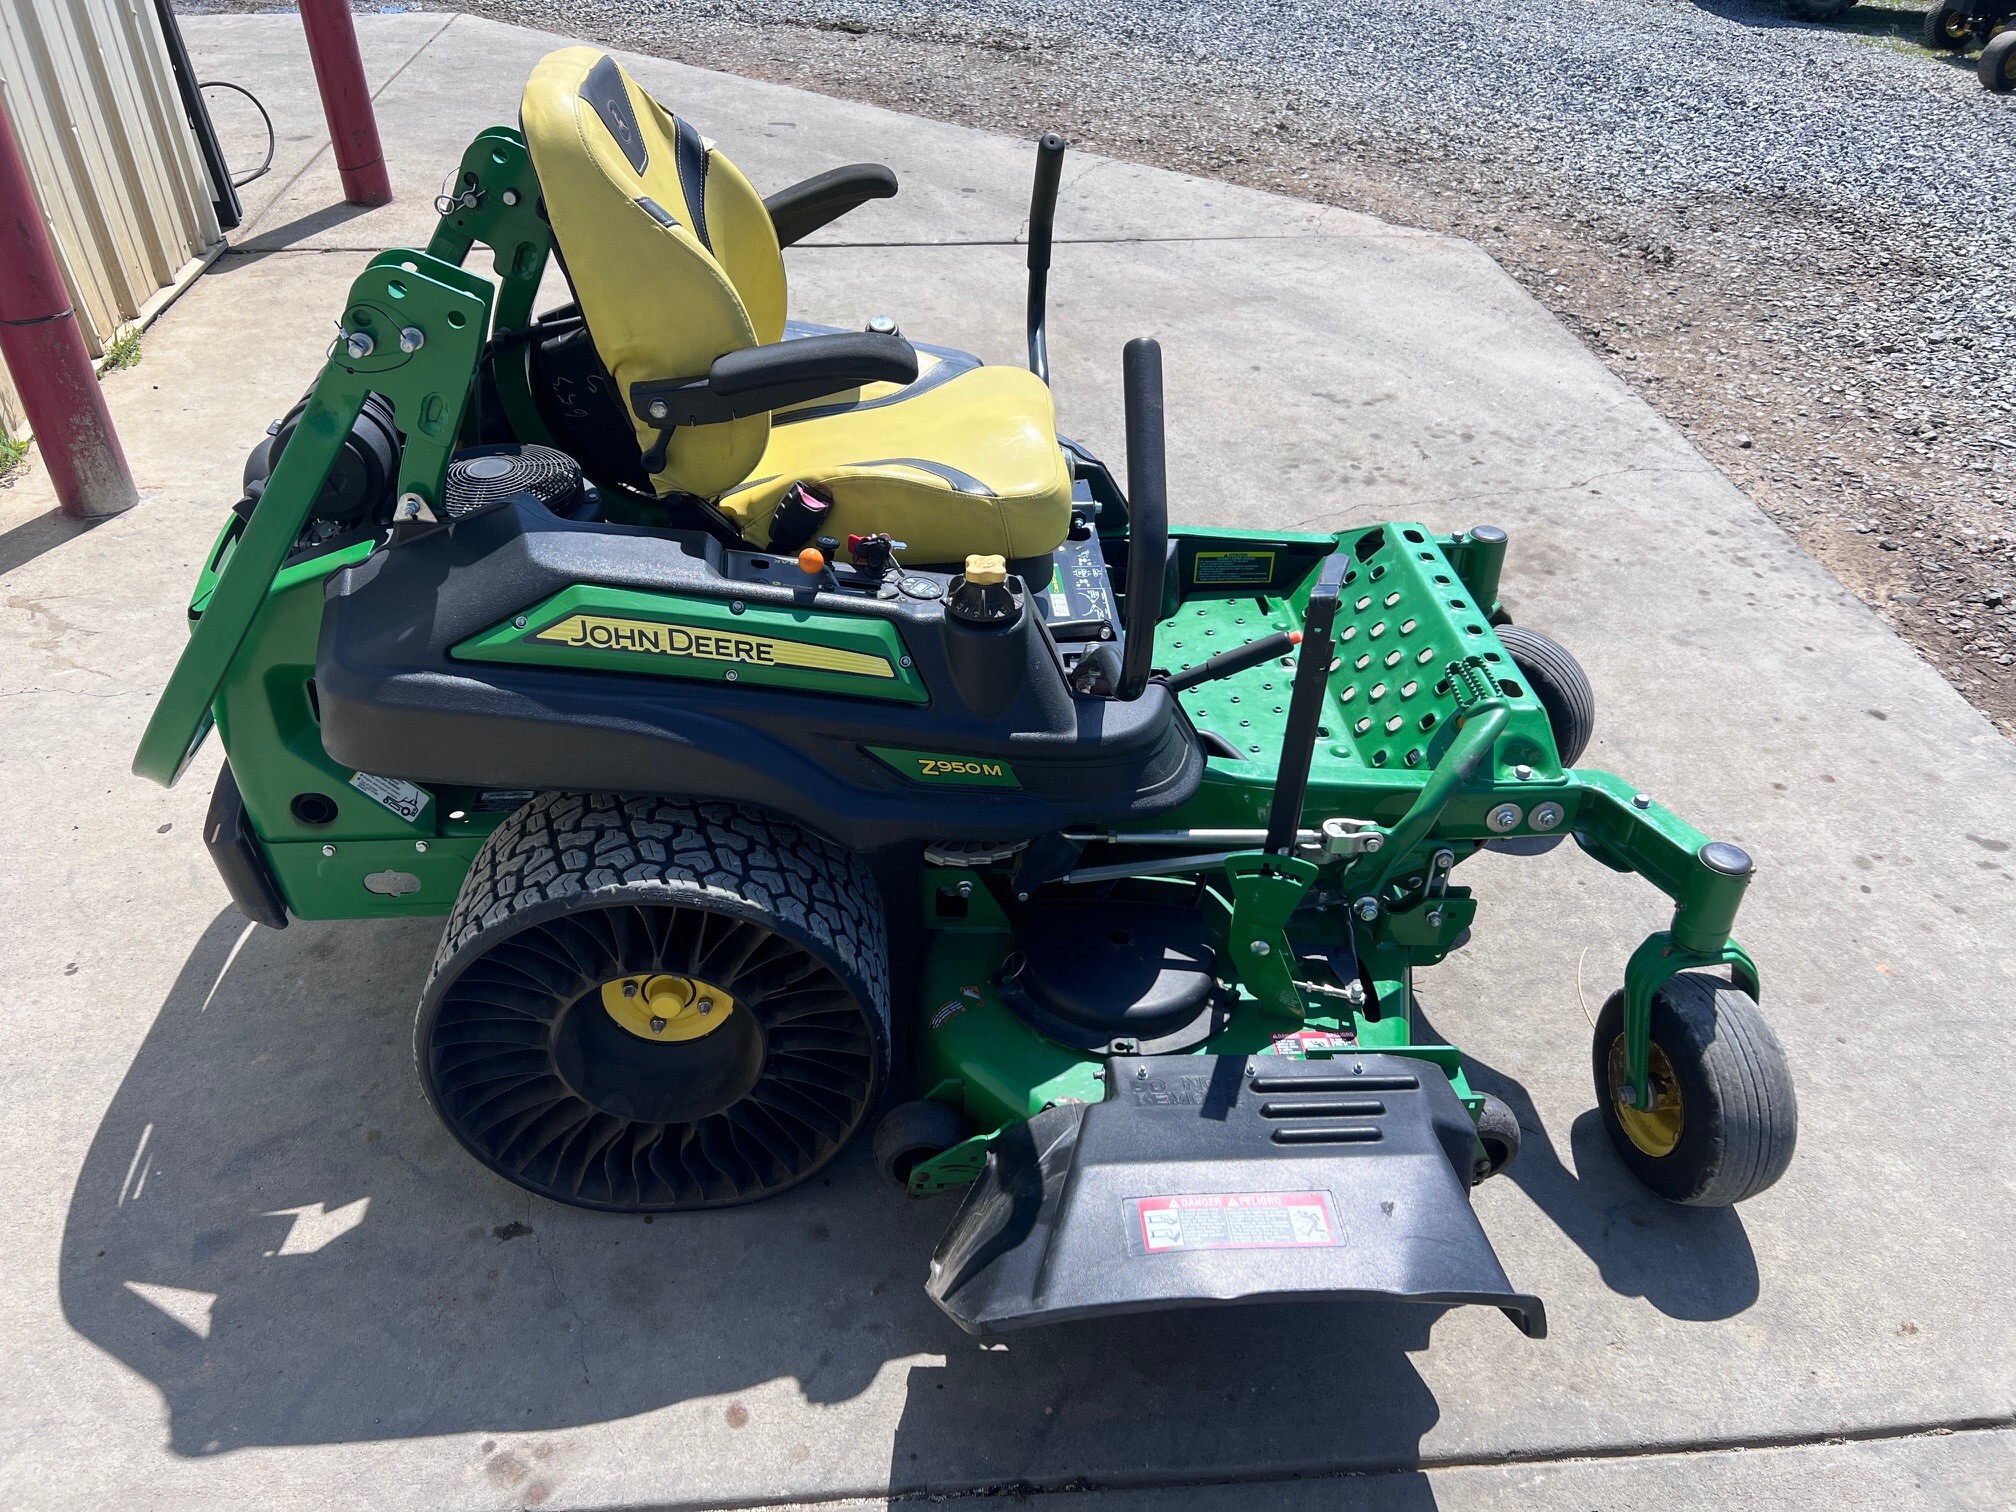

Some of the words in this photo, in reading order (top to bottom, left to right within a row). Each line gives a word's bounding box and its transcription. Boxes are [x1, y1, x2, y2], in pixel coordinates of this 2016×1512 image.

[570, 619, 661, 651] JOHN
[668, 628, 775, 663] DEERE
[1180, 1197, 1222, 1207] DANGER
[1239, 1196, 1282, 1206] PELIGRO
